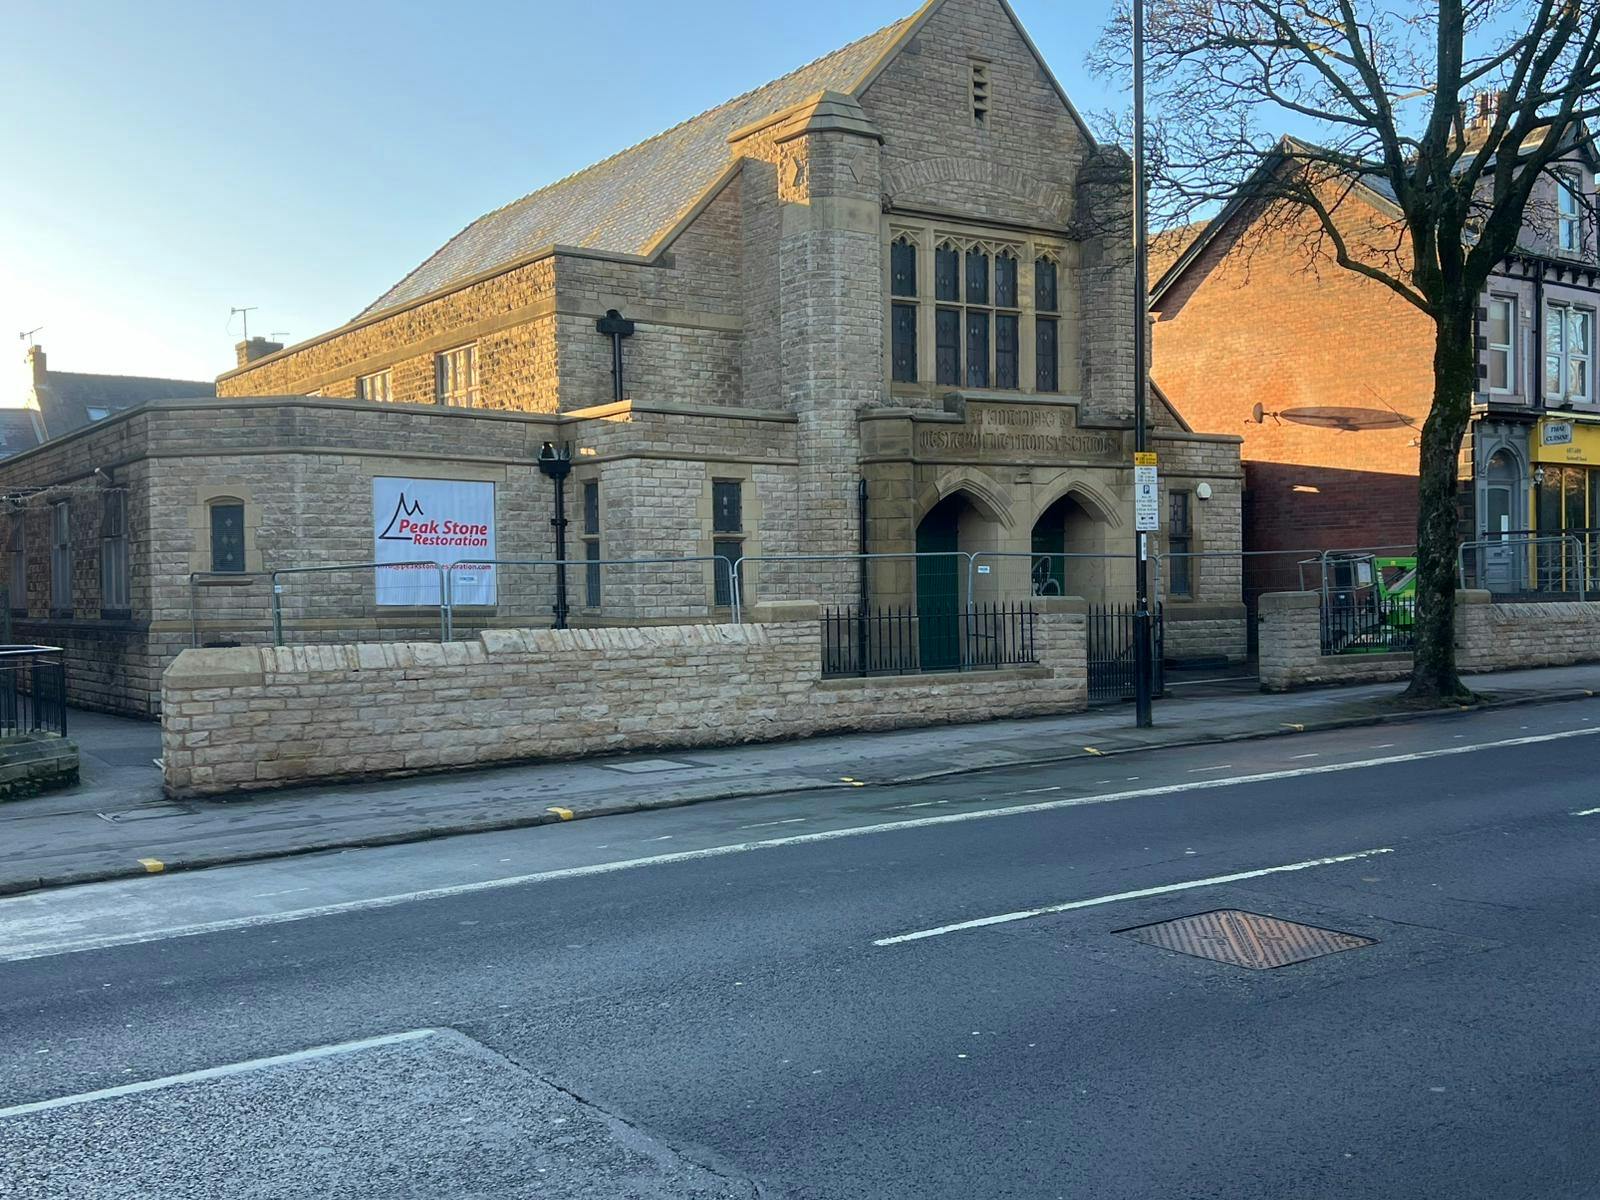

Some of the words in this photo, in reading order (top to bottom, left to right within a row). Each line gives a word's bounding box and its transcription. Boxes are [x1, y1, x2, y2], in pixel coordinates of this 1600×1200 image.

[399, 519, 439, 534] Peak
[442, 520, 488, 535] Stone
[413, 534, 488, 547] Restoration
